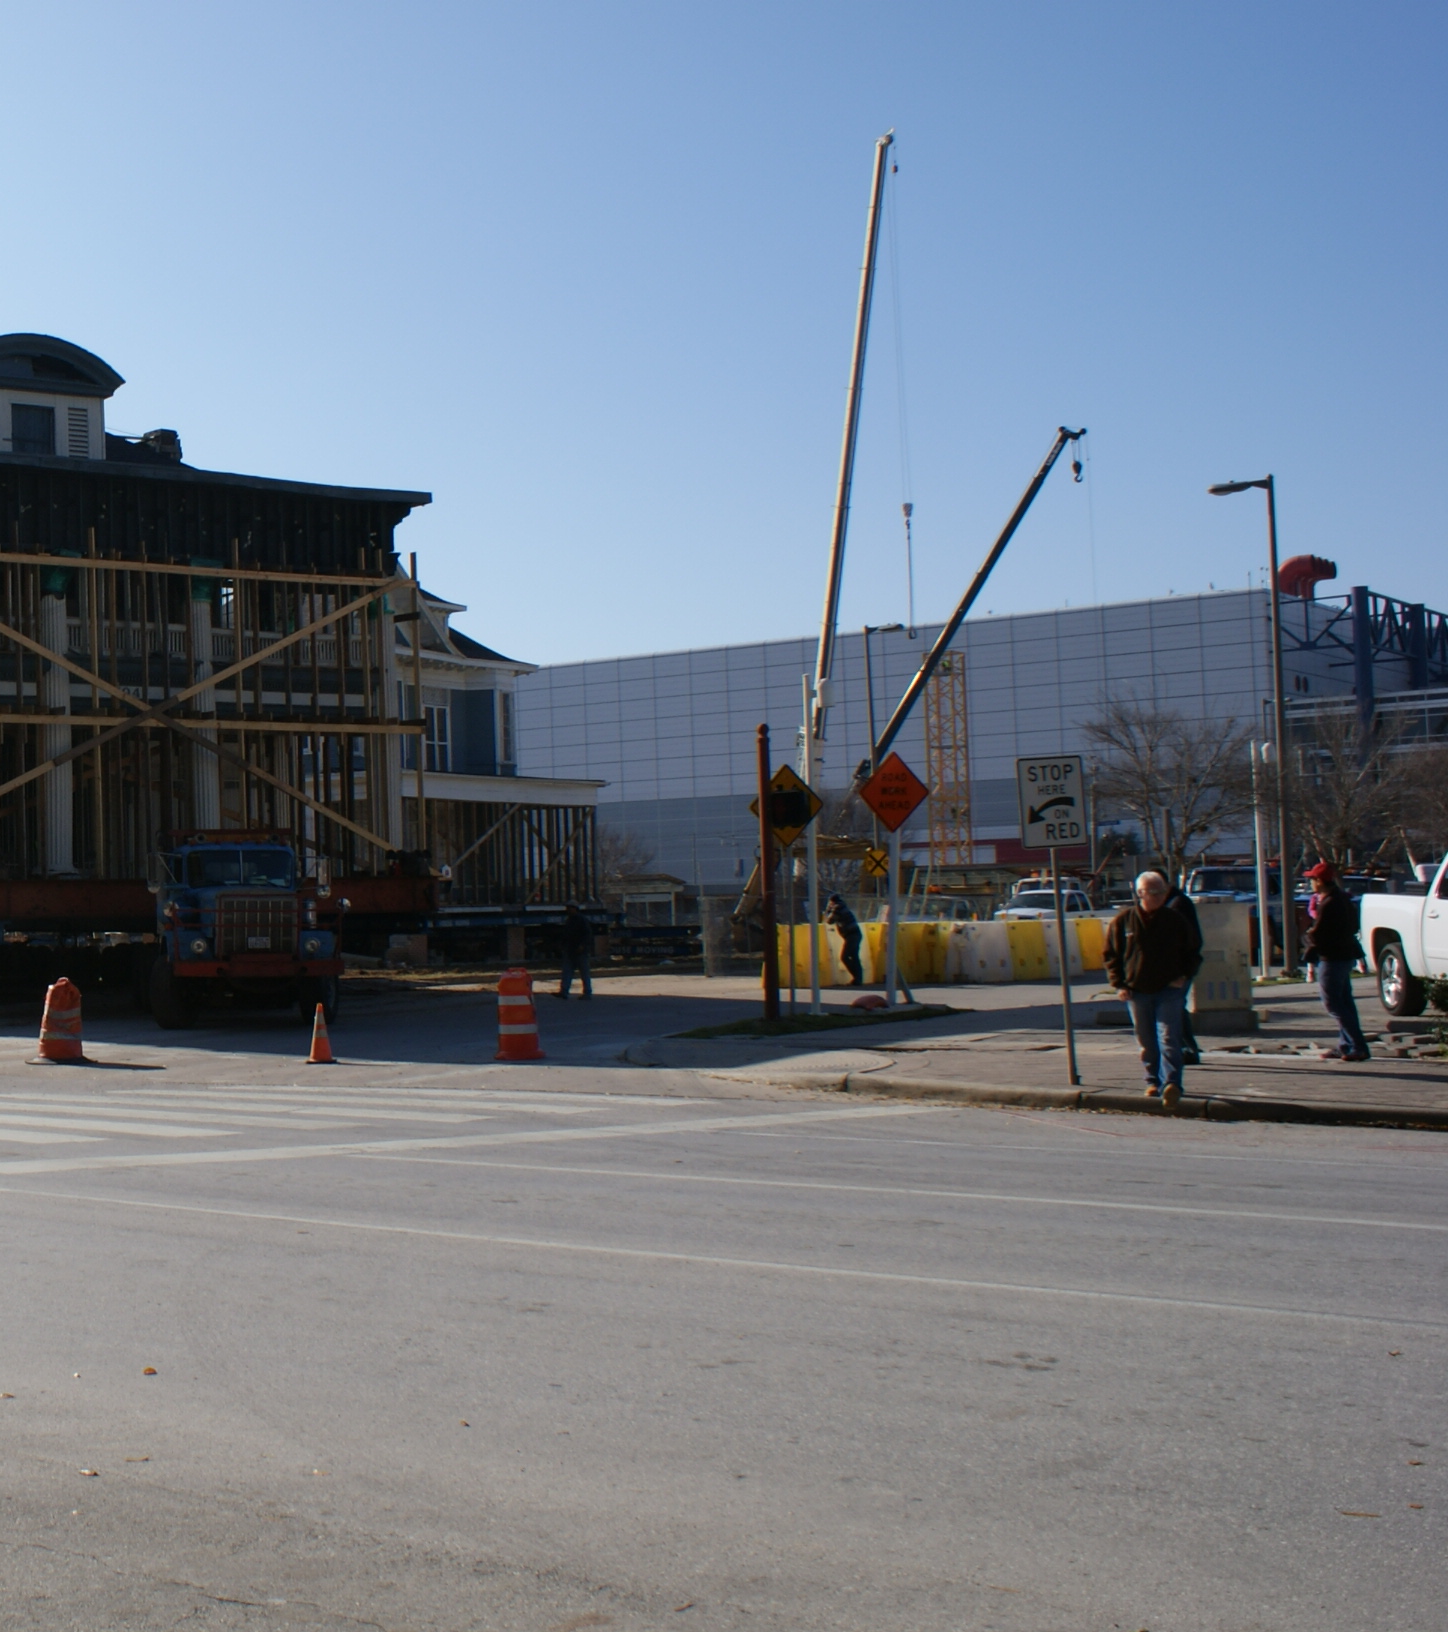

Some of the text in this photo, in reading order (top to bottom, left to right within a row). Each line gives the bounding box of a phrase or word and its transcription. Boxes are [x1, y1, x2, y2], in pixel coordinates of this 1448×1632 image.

[881, 772, 907, 782] ROAD
[1027, 764, 1073, 782] STOP
[881, 786, 907, 796] WORK
[1037, 784, 1066, 796] HERE
[879, 800, 911, 810] AHEAD
[1054, 809, 1069, 820] ON
[1045, 822, 1080, 841] RED
[636, 946, 675, 954] MOVING
